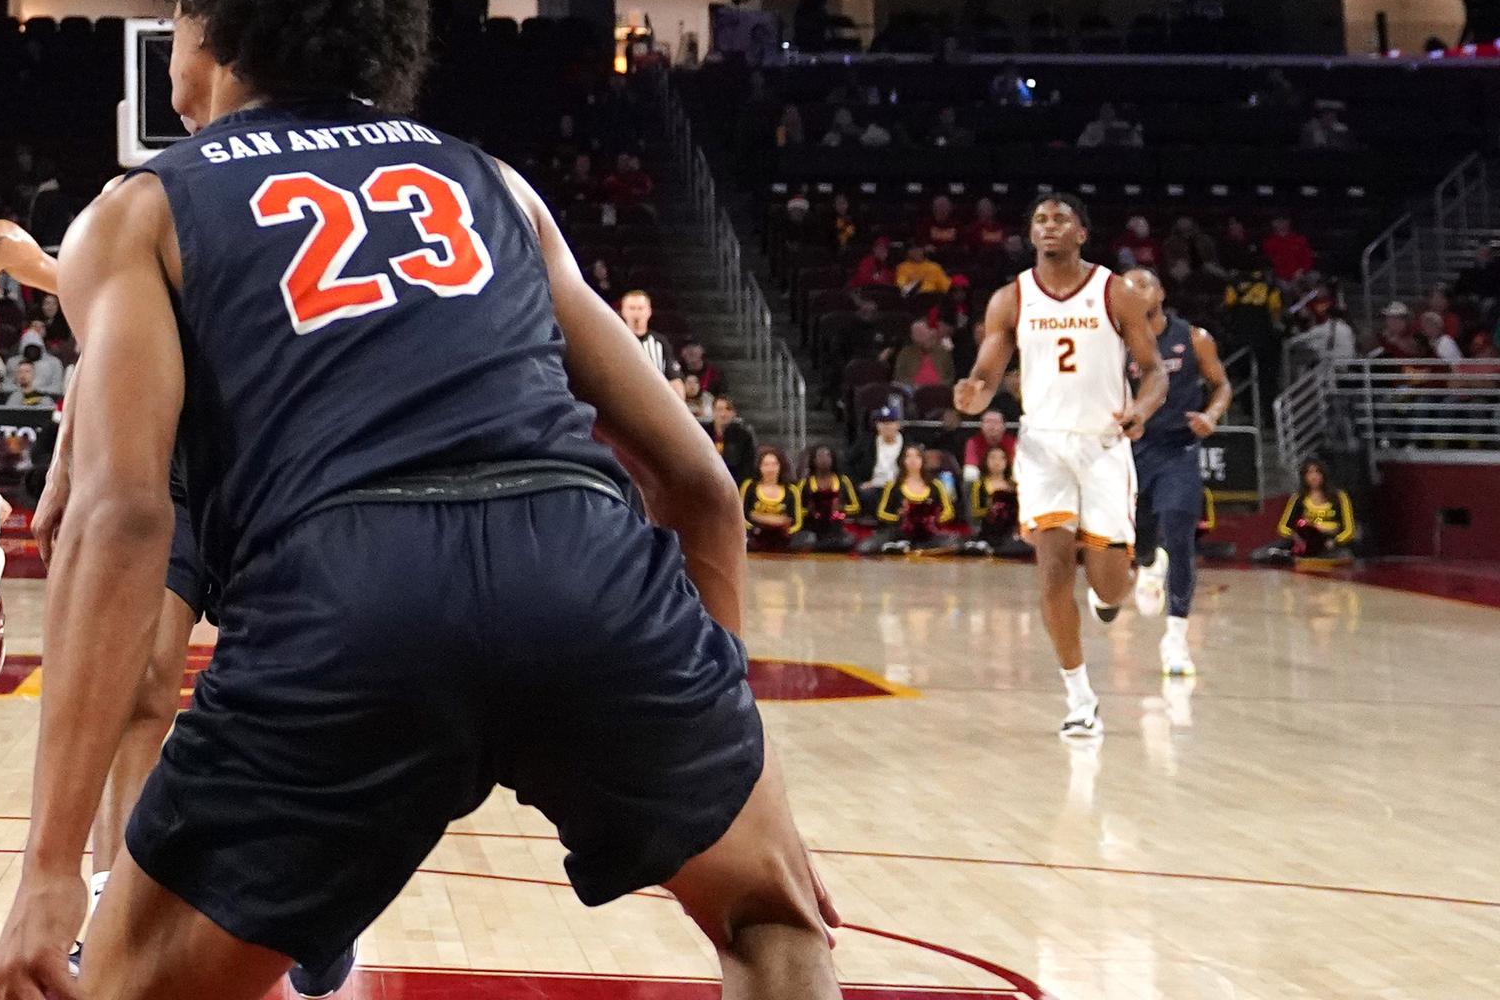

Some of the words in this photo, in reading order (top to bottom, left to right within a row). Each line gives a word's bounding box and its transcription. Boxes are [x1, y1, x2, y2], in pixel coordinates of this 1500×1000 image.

[201, 130, 282, 164] SAN
[288, 120, 442, 151] ANTONIO
[249, 163, 495, 335] 23
[1029, 317, 1100, 331] TROJANS
[1057, 337, 1077, 373] 2
